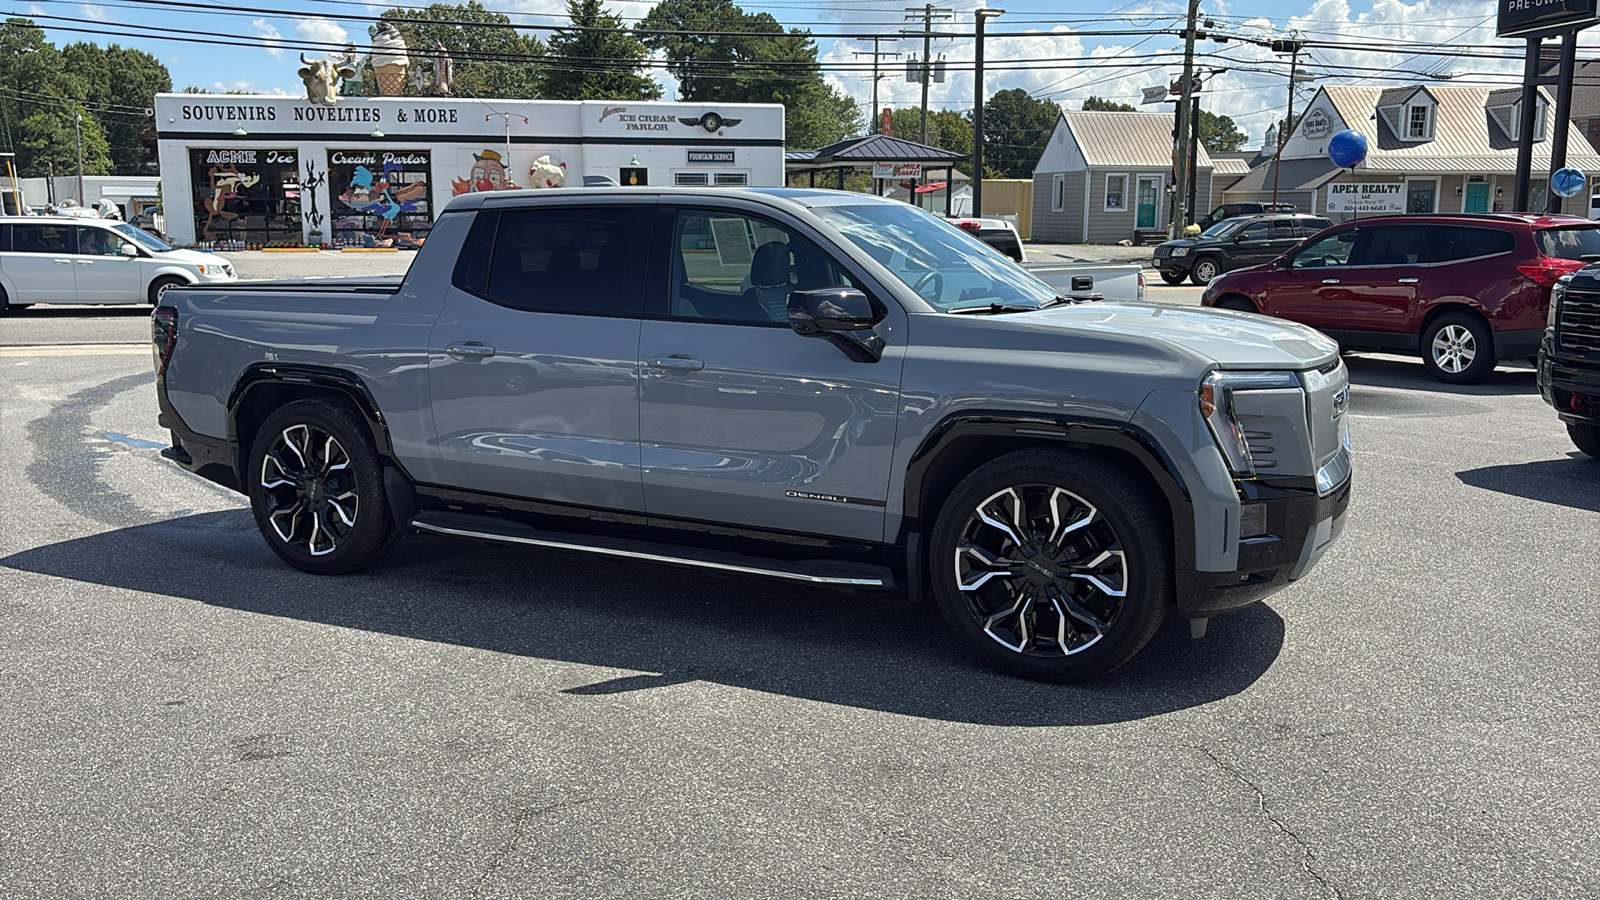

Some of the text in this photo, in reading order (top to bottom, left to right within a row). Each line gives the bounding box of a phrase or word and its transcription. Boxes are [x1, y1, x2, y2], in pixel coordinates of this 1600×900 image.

[1508, 0, 1564, 12] PRE-O
[182, 105, 458, 123] SOUVENIRS NOVELTIES & MORE
[619, 114, 636, 122] ICE
[626, 123, 669, 131] PARLOR
[206, 150, 296, 164] ACME Ice
[331, 151, 429, 165] Cream Parlor
[689, 153, 734, 161] FOUNTAIN SERVICE
[1332, 184, 1401, 194] APEX REALTY
[786, 491, 847, 502] DENALI
